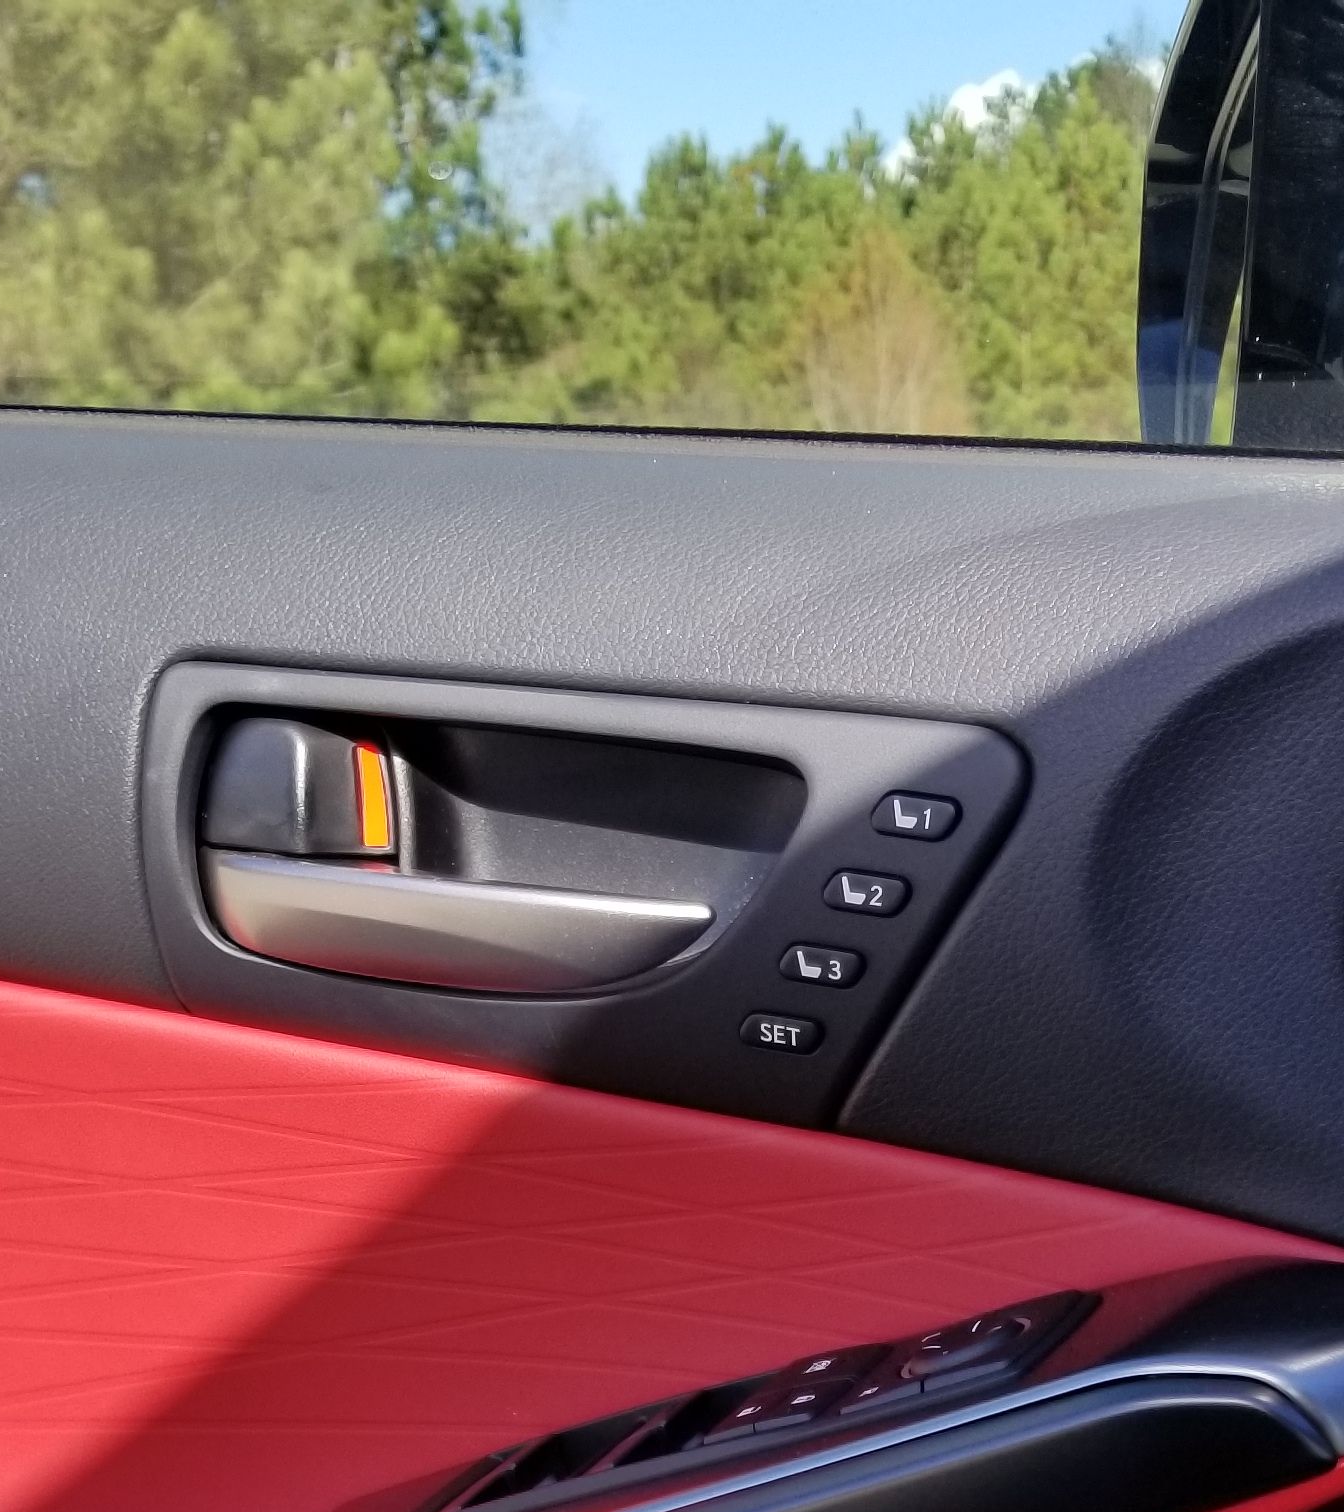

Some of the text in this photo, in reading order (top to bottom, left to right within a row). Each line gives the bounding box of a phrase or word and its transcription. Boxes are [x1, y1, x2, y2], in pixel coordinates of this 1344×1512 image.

[922, 808, 932, 830] 1
[868, 885, 884, 907] 2
[827, 959, 843, 981] 3
[759, 1023, 801, 1047] SET
